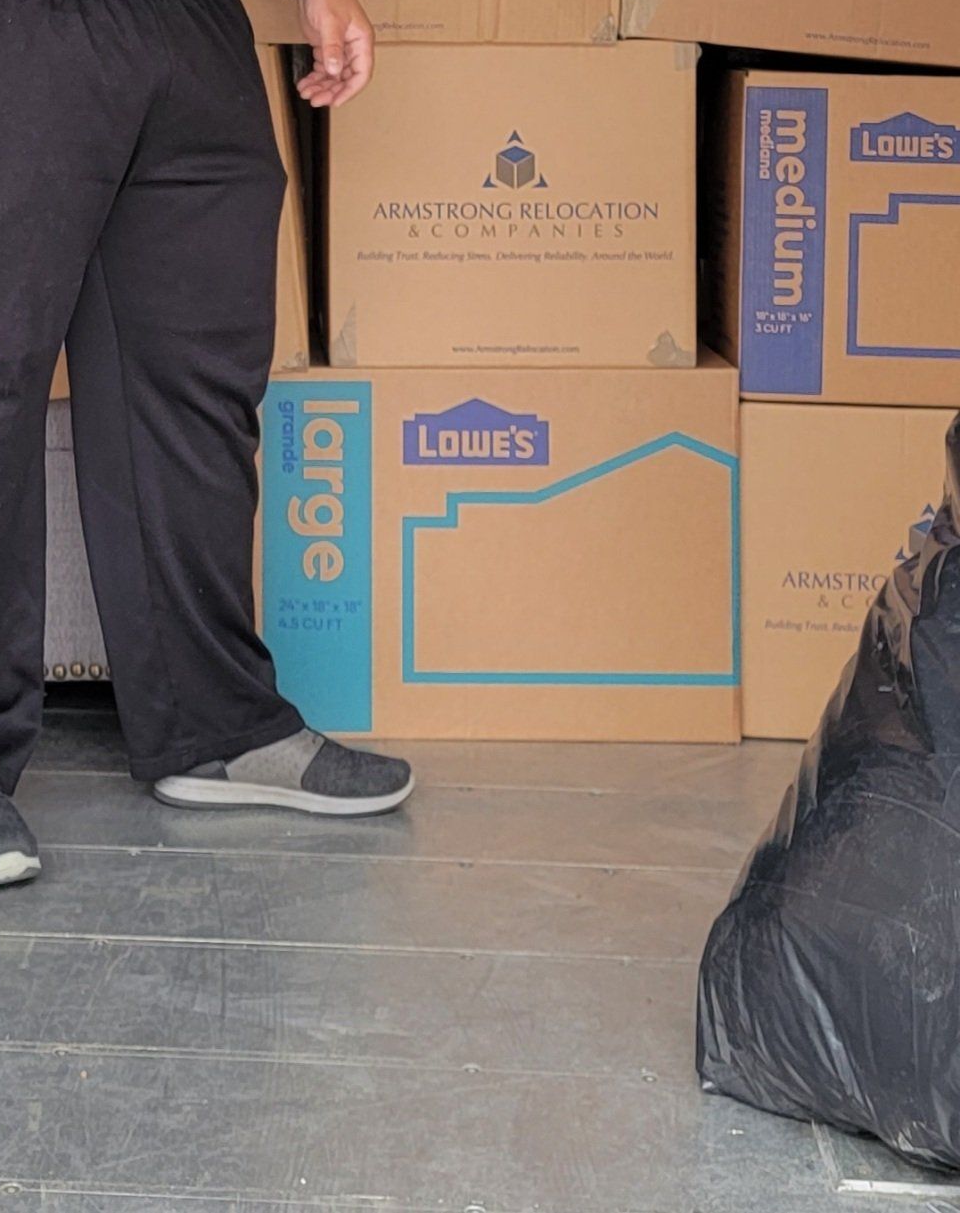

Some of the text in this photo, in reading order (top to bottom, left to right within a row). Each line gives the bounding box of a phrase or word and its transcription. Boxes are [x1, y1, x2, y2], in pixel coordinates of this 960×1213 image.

[759, 109, 772, 180] mediana
[860, 130, 954, 160] LOWE'S
[372, 202, 660, 220] ARMSTRONG RELOCATION
[772, 108, 817, 307] medium
[408, 224, 625, 238] & COMPANIES
[755, 323, 793, 334] 3 CU FT
[278, 401, 296, 474] grande
[418, 424, 535, 459] LOWE'S
[287, 399, 360, 583] large
[302, 602, 310, 612] x
[333, 603, 341, 612] x
[278, 616, 344, 632] 4.5 CU FT
